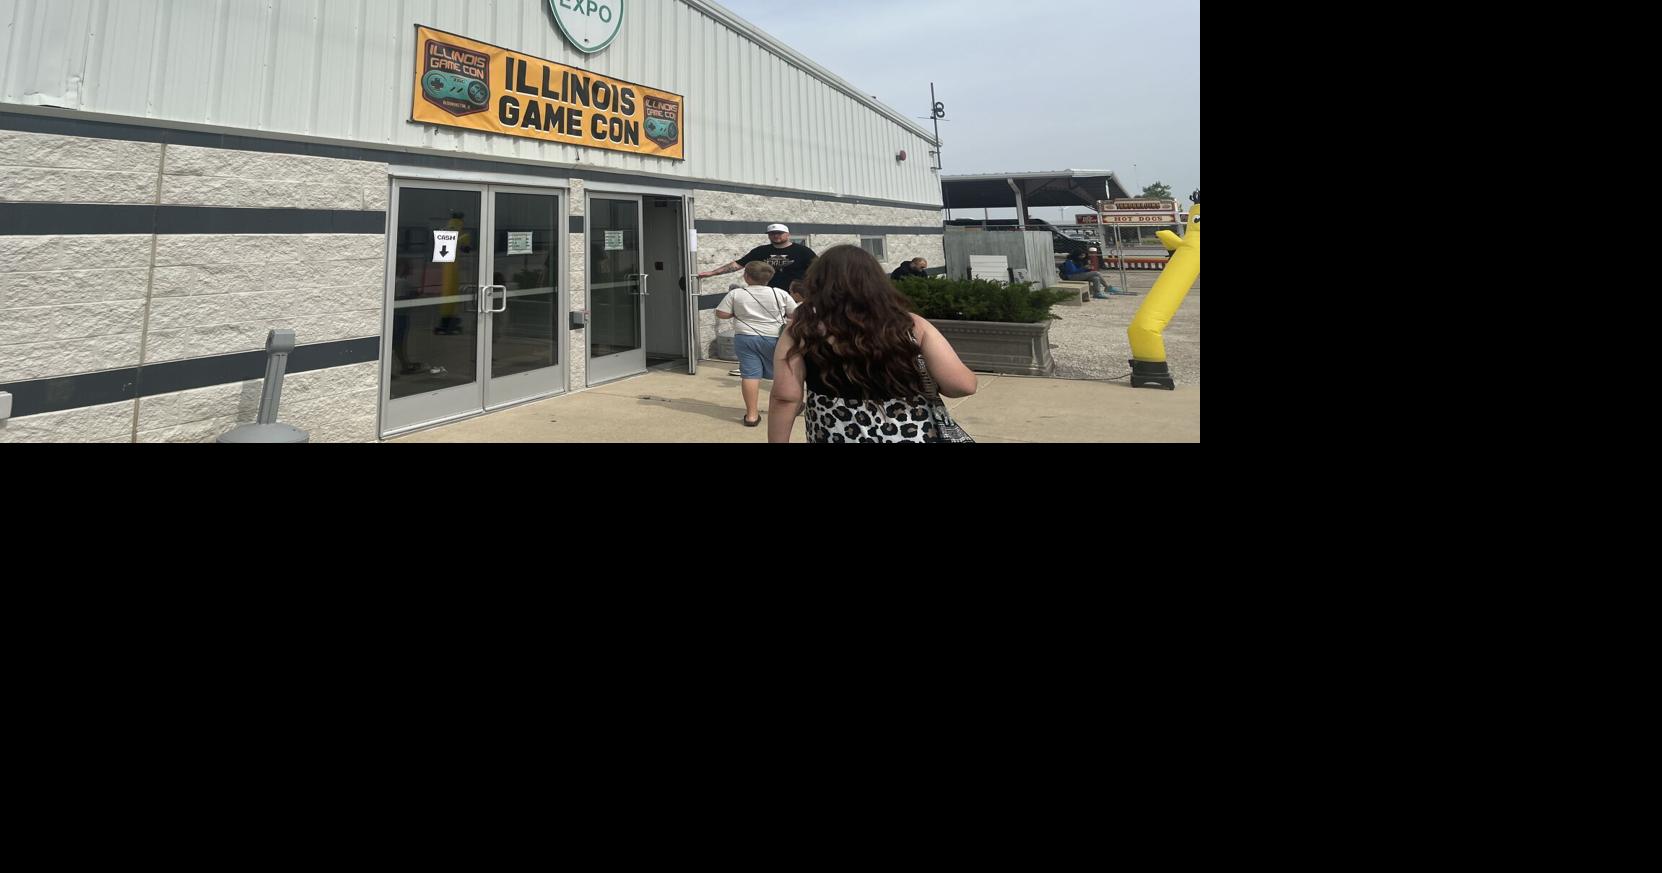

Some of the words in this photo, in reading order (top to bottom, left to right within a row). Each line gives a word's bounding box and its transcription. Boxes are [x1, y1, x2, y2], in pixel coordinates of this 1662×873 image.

[560, 0, 611, 23] EXPO
[430, 44, 486, 68] ILLINOIS
[430, 57, 461, 72] GAME
[463, 65, 484, 79] CON
[505, 56, 636, 116] ILLINOIS
[498, 95, 583, 138] GAME
[590, 113, 640, 147] CON
